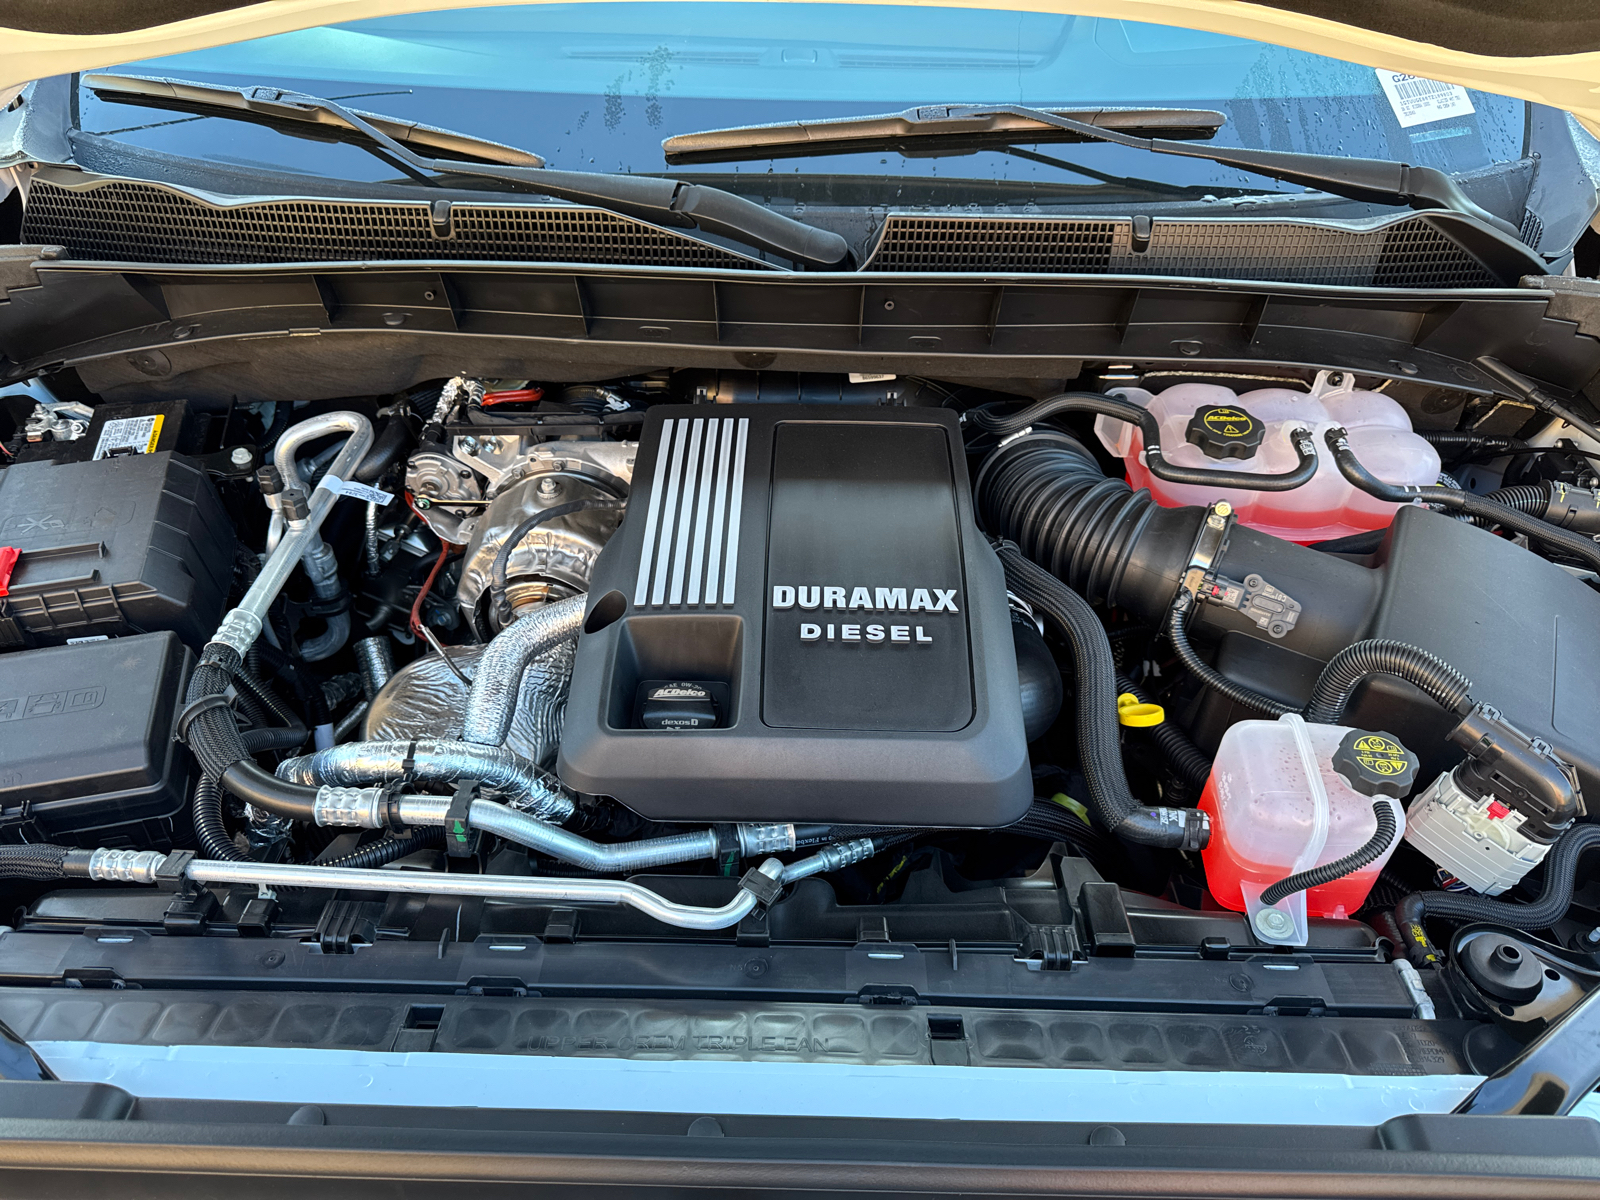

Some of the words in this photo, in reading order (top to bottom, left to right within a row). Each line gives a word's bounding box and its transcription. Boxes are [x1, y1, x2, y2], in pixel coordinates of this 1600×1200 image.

[772, 585, 959, 613] DURAMAX
[800, 623, 933, 644] DIESEL
[653, 688, 706, 698] ACDelco
[526, 1035, 609, 1051] UPPER
[692, 1035, 776, 1051] TRIPLE
[784, 1036, 829, 1052] FAN
